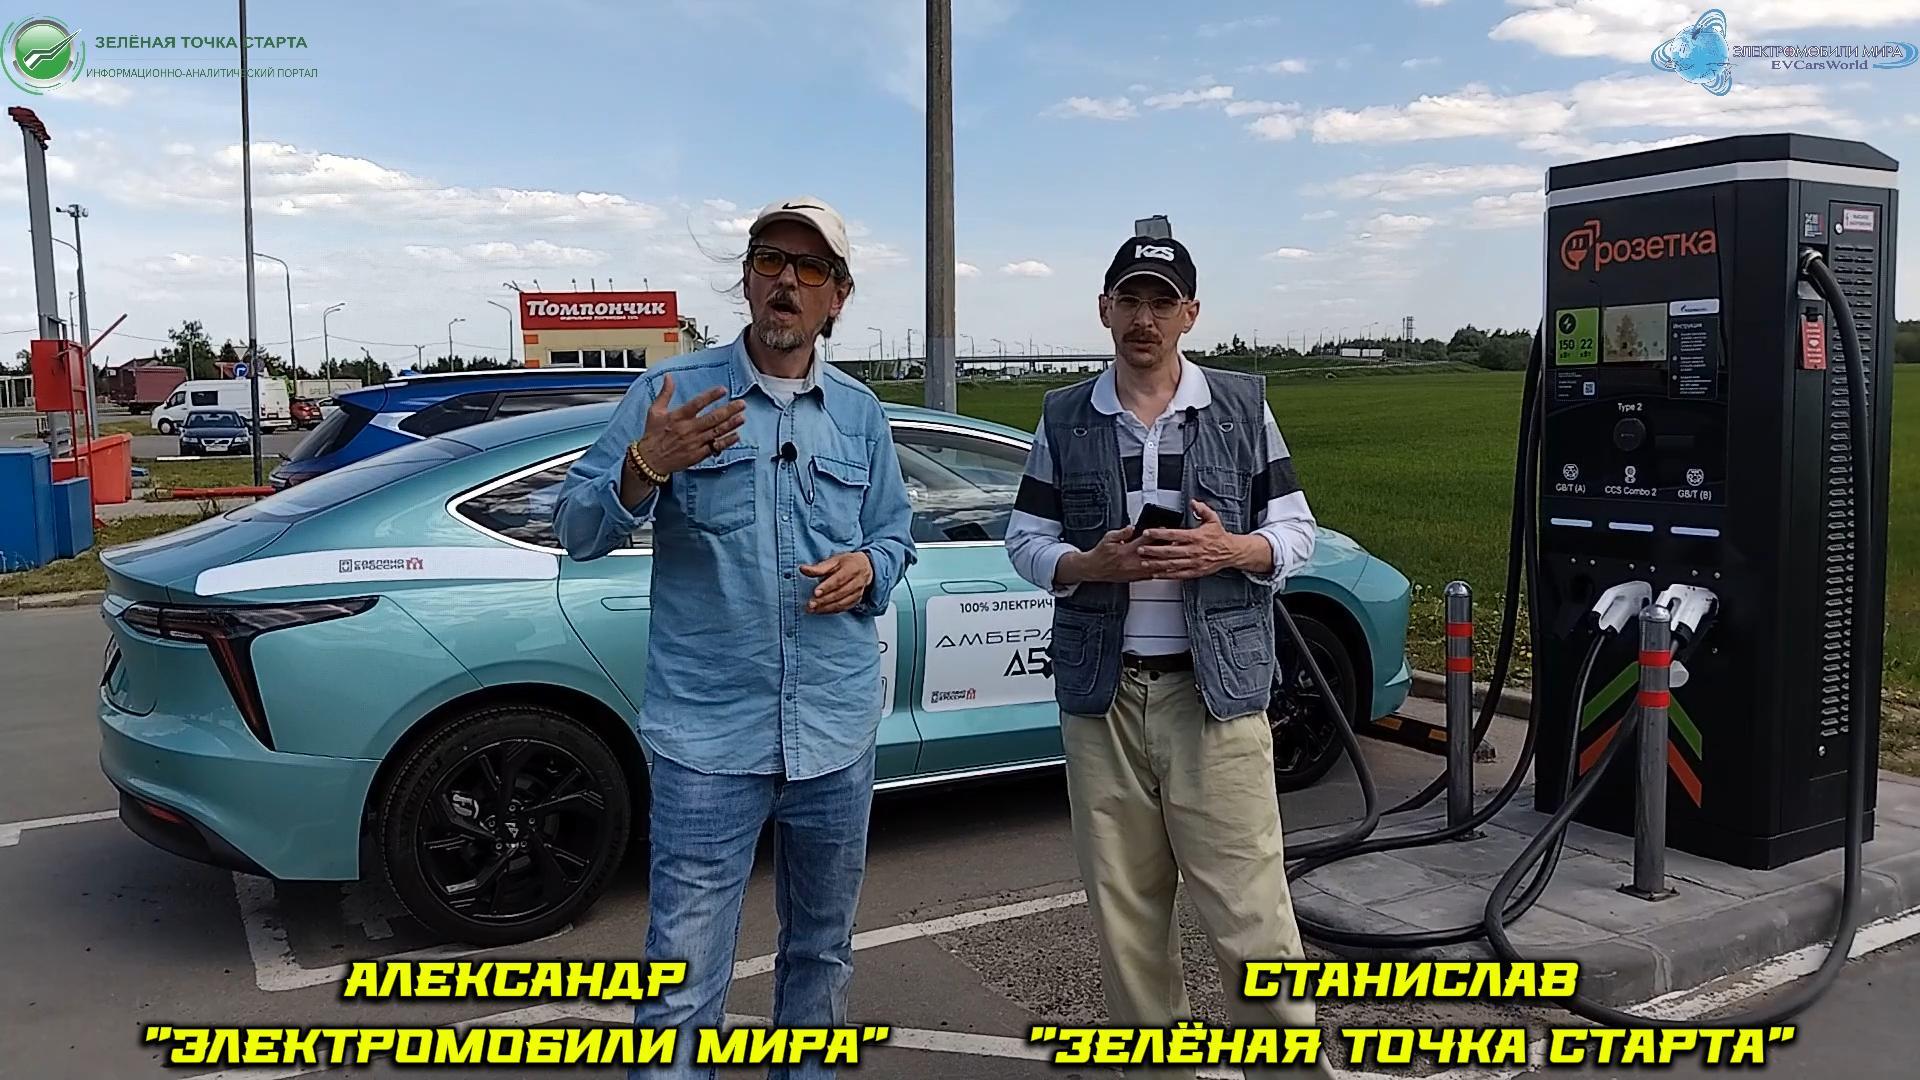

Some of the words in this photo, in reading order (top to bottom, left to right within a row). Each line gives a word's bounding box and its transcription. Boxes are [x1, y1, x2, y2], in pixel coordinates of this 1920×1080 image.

[526, 300, 666, 317] Помпончик
[1559, 339, 1576, 350] 150
[1580, 338, 1593, 350] 22
[1617, 402, 1635, 413] Type
[1636, 403, 1643, 411] 2
[1574, 484, 1586, 494] (A)
[1604, 485, 1622, 495] CCS
[1623, 486, 1650, 496] Combo
[1651, 488, 1657, 496] 2
[959, 602, 990, 614] 100%
